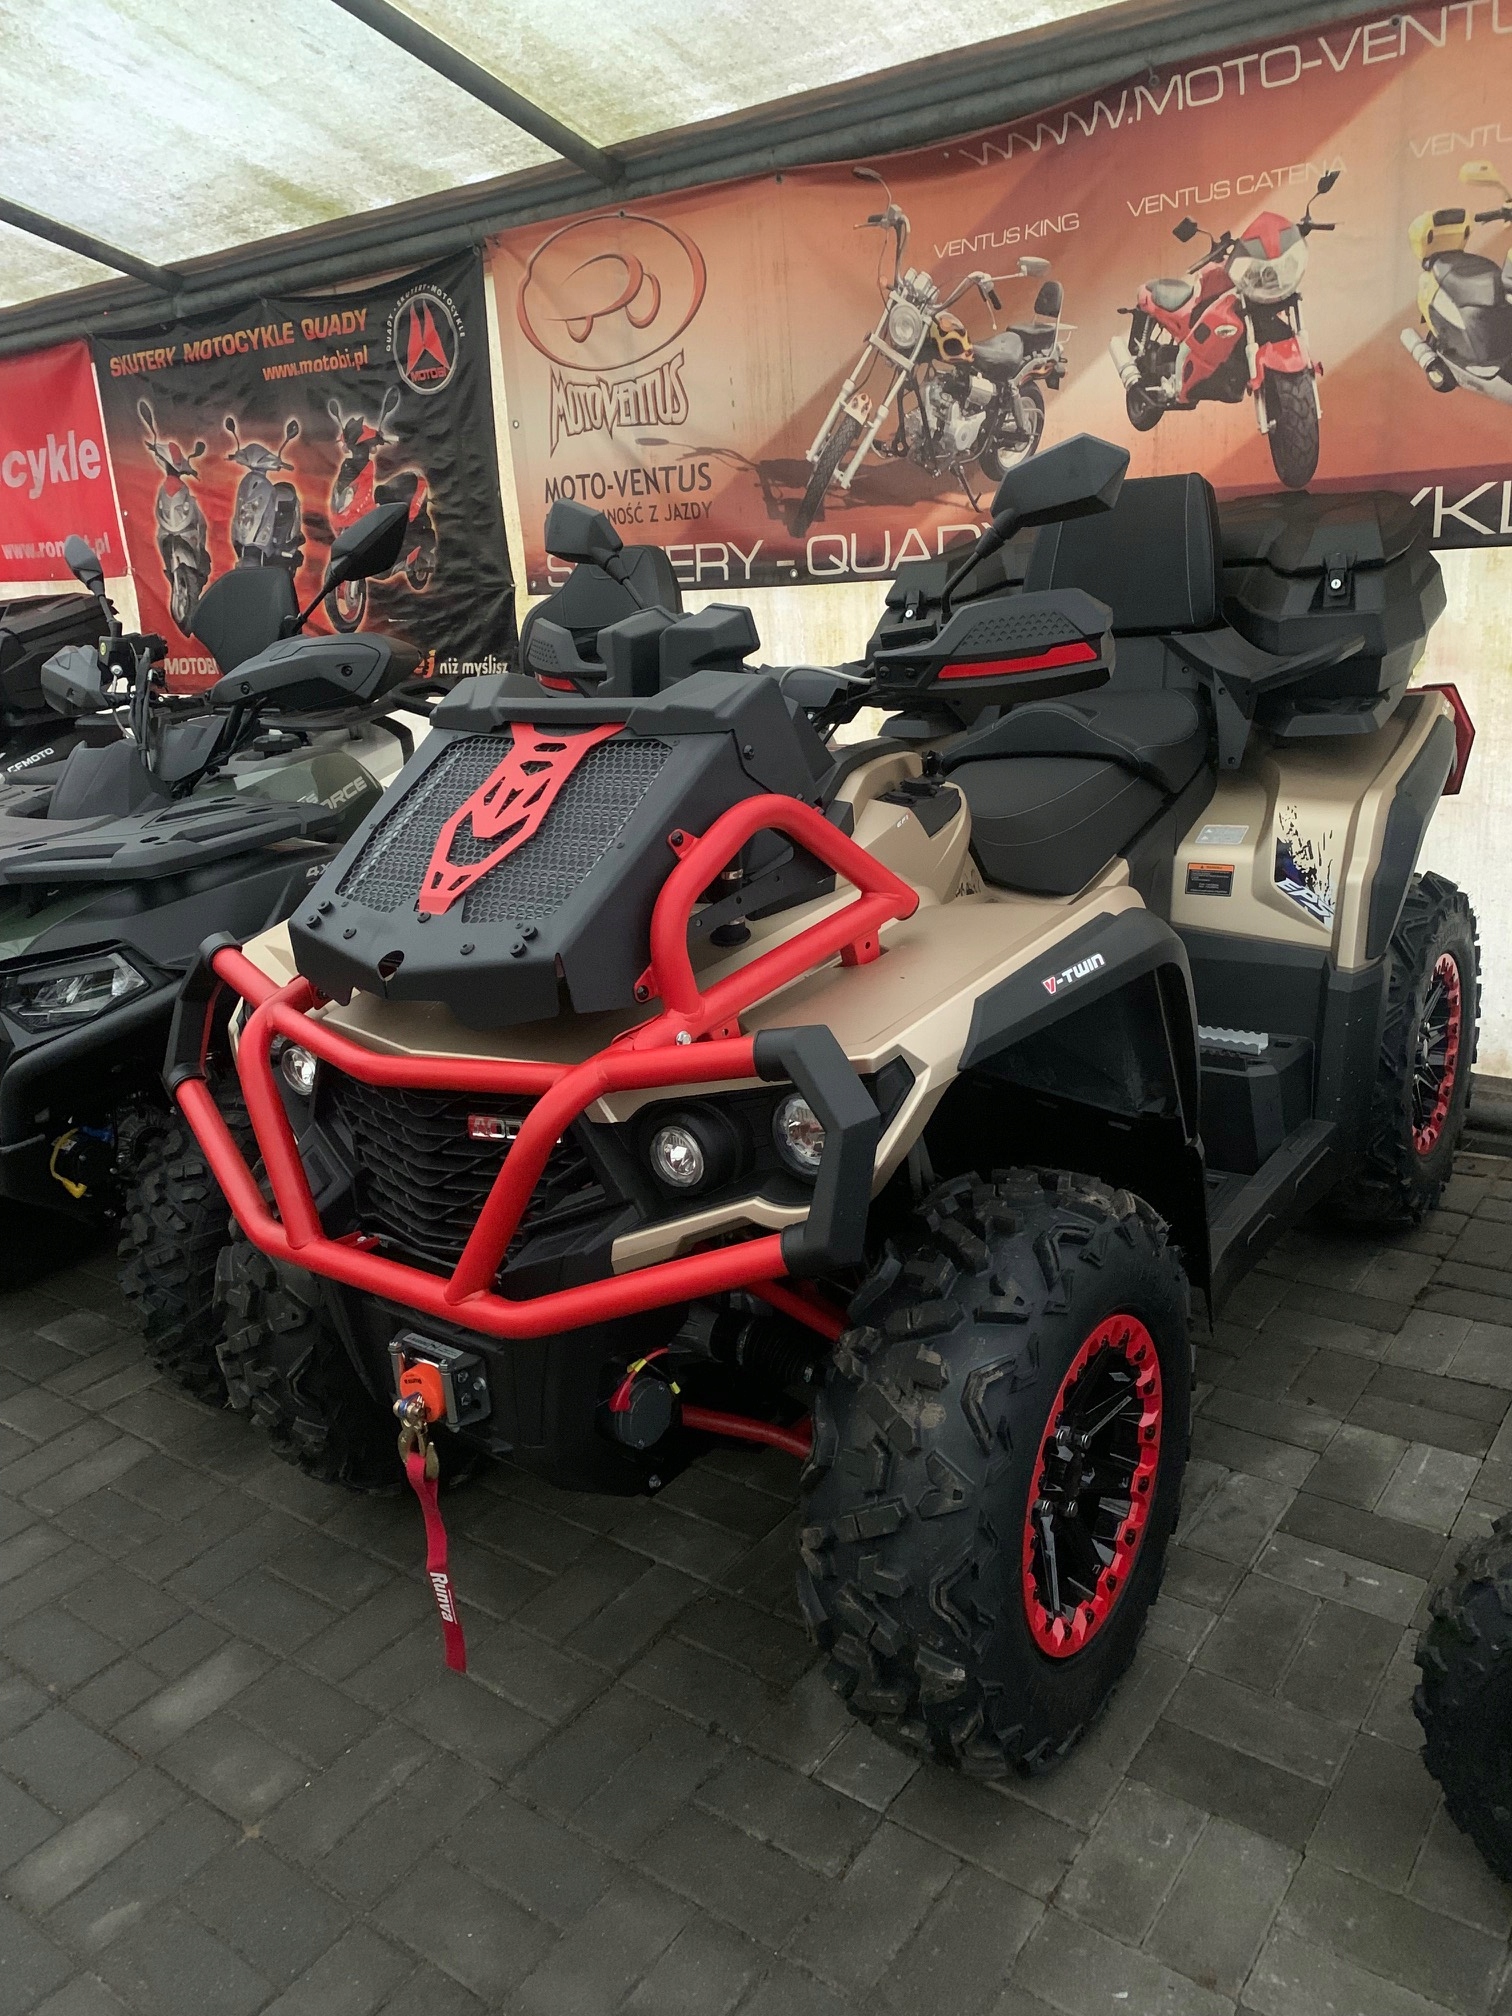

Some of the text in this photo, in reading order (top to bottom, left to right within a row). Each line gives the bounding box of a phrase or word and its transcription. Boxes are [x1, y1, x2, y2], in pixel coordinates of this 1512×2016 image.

[1126, 156, 1348, 217] VENTUS CATENA
[934, 213, 1080, 259] VENTUS KING
[109, 308, 368, 378] SKUTERY MOTOCYKLE QUADY
[262, 345, 368, 382] www.motobi.pl
[2, 430, 101, 499] cykle
[545, 463, 712, 504] MOTO-VENTUS
[649, 508, 659, 523] Z
[664, 501, 713, 521] JAZDY
[806, 522, 993, 576] QUAD
[439, 657, 459, 675] niż
[462, 654, 508, 677] myślisz
[7, 747, 55, 773] CFMOTO
[1275, 877, 1335, 917] EPS
[1042, 953, 1105, 995] V-TWIN
[430, 1571, 454, 1623] Runva
